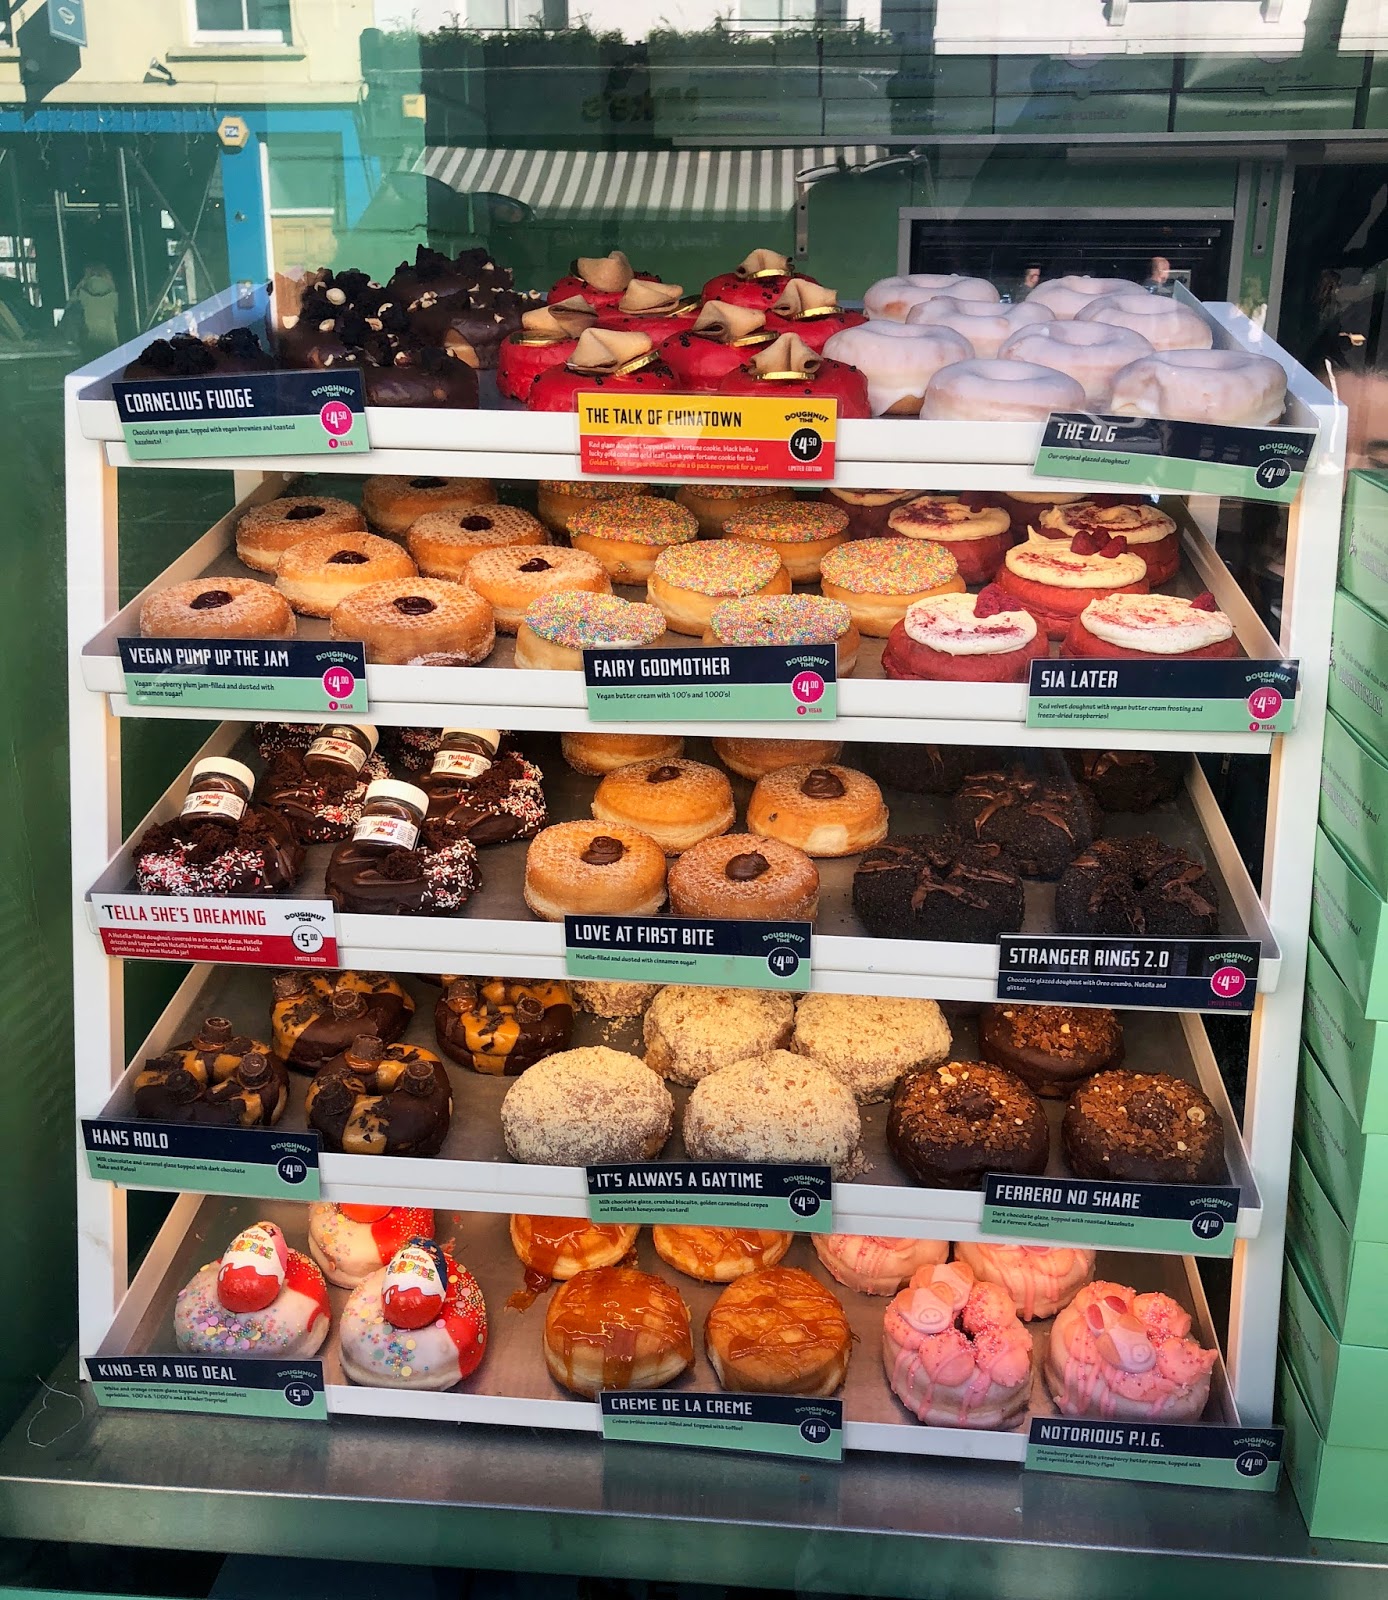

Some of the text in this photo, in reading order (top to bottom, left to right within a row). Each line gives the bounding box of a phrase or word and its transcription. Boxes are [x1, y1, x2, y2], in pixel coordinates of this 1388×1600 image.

[311, 385, 355, 396] DOUGHNUT
[125, 388, 254, 413] CORNELIUS FUDGE
[586, 408, 742, 427] THE TALK OF CHINATOWN
[785, 411, 829, 423] DOUGHNUT
[190, 428, 209, 436] topped
[1057, 423, 1118, 442] THE O.G
[1259, 444, 1304, 456] DOUGHNUT
[1059, 454, 1081, 463] original
[129, 648, 289, 667] VEGAN PUMP UP THE JAM
[316, 651, 358, 662] DOUGHNUT
[786, 656, 830, 667] DOUGHNUT
[594, 657, 730, 677] FAIRY GODMOTHER
[1041, 671, 1118, 689] SIA LATER
[1246, 671, 1291, 683] DOUGHNUT
[135, 680, 152, 688] Vegan
[183, 682, 196, 690] plum
[1068, 703, 1096, 711] doughnut
[1167, 705, 1191, 713] frosting
[325, 740, 352, 750] nutella
[448, 754, 474, 763] nutella
[196, 792, 224, 801] nutella
[370, 819, 398, 829] nutella
[102, 905, 266, 926] 'TELLA SHE'S DREAMING
[284, 912, 326, 922] DOUGHNUT
[575, 924, 714, 946] LOVE AT FIRST BITE
[762, 932, 805, 943] DOUGHNUT
[1009, 948, 1169, 968] STRANGER RINGS 2.0
[1208, 952, 1253, 963] DOUGHNUT
[1055, 978, 1082, 986] doughnut
[92, 1129, 169, 1149] HANS ROLO
[271, 1142, 311, 1153] DOUGHNUT
[597, 1172, 763, 1189] IT'S ALWAYS A GAYTIME
[783, 1175, 825, 1186] DOUGHNUT
[996, 1185, 1141, 1209] FERRERO NO SHARE
[1190, 1197, 1233, 1208] DOUGHNUT
[400, 1252, 428, 1264] Kinder
[98, 1364, 237, 1381] KIND-ER A BIG DEAL
[276, 1370, 318, 1379] DOUGHNUT
[611, 1398, 752, 1415] CREME DE LA CREME
[795, 1407, 836, 1417] DOUGHNUT
[1041, 1425, 1164, 1448] NOTORIOUS P.I.G.
[1233, 1437, 1277, 1448] DOUGHNUT
